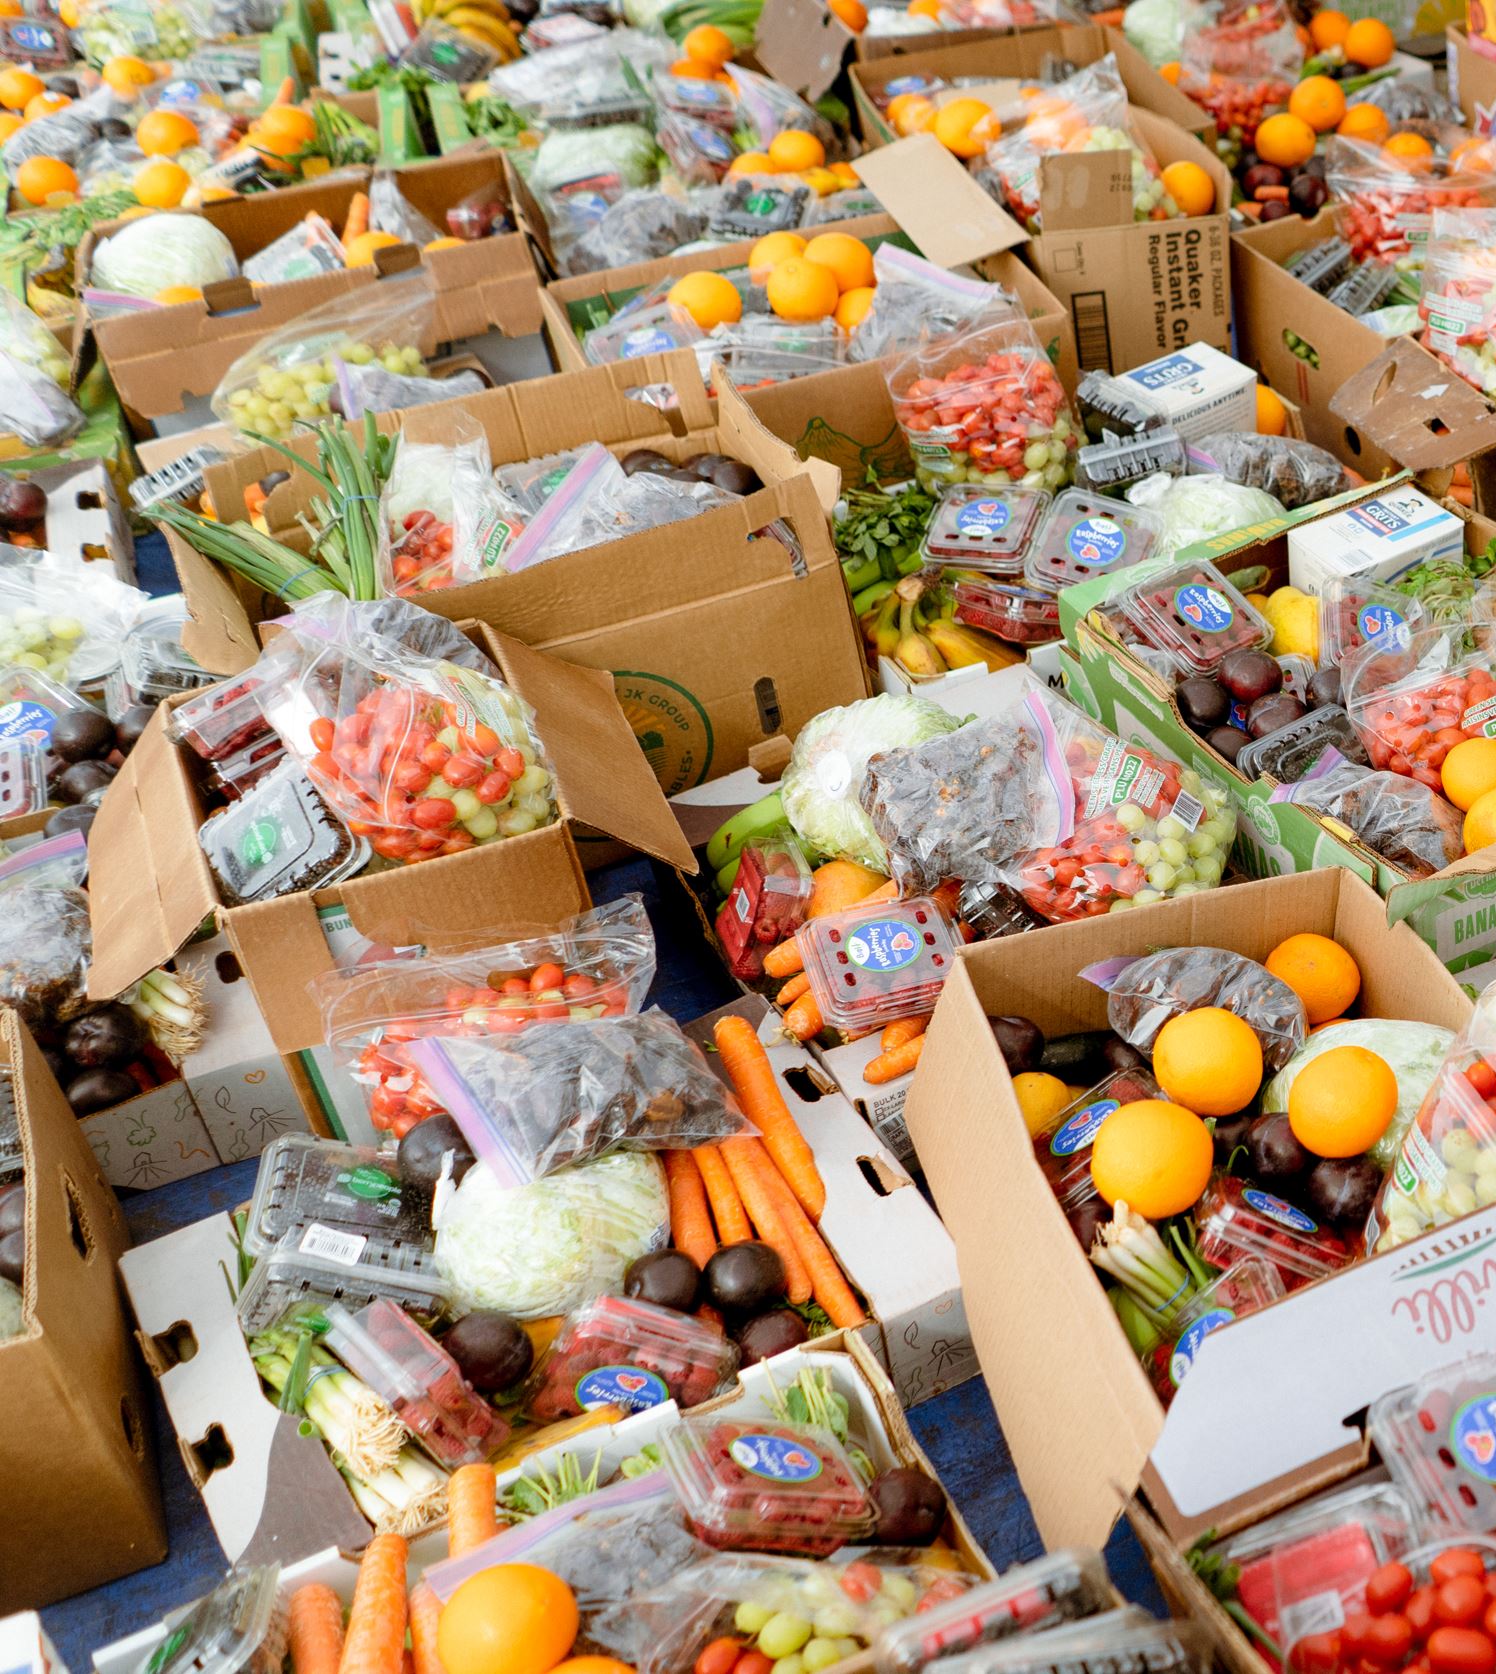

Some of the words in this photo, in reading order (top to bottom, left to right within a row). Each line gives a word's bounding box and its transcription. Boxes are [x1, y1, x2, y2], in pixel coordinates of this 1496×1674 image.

[1149, 234, 1164, 297] Regular
[1166, 232, 1186, 312] Instant
[1154, 301, 1167, 349] Flavor
[1172, 319, 1189, 351] Gri
[1143, 361, 1194, 387] GRITS
[1172, 402, 1212, 426] DELICIOUS
[1213, 387, 1247, 409] ANYTIME.
[1365, 505, 1401, 529] GRITS
[1189, 588, 1225, 625] Raspberries
[624, 688, 645, 701] JK
[649, 694, 690, 732] GROUP
[1114, 781, 1128, 799] PLU
[324, 918, 353, 933] BUN
[868, 927, 892, 967] Raspberries
[873, 1095, 897, 1109] BULK
